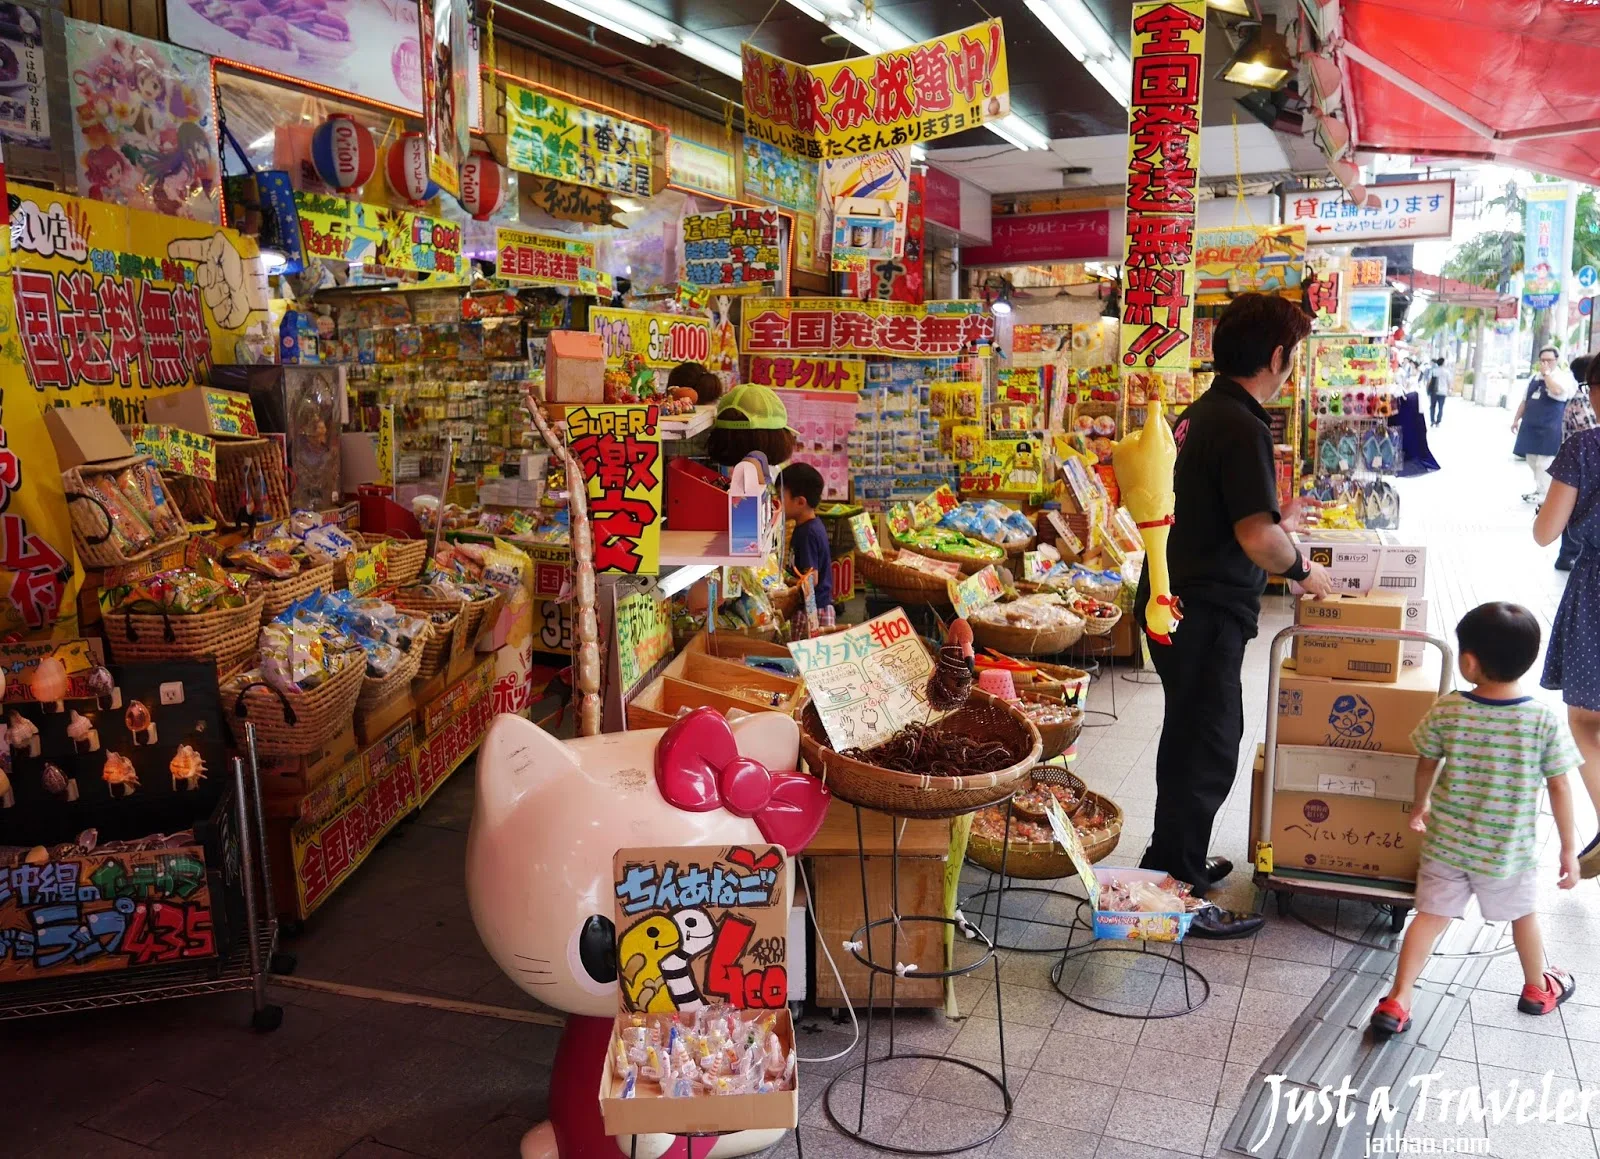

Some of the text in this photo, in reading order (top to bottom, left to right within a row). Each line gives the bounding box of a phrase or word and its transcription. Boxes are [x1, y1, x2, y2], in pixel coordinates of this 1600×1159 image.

[336, 126, 355, 173] Orion
[463, 164, 478, 204] Orion
[1334, 217, 1416, 233] とみやビル 3F
[752, 357, 851, 390] 紅芋タルト
[567, 405, 659, 441] SUPER!
[869, 617, 911, 648] ¥100
[1316, 732, 1383, 751] Nambo
[614, 864, 778, 916] ちんあなご
[119, 901, 215, 965] 435
